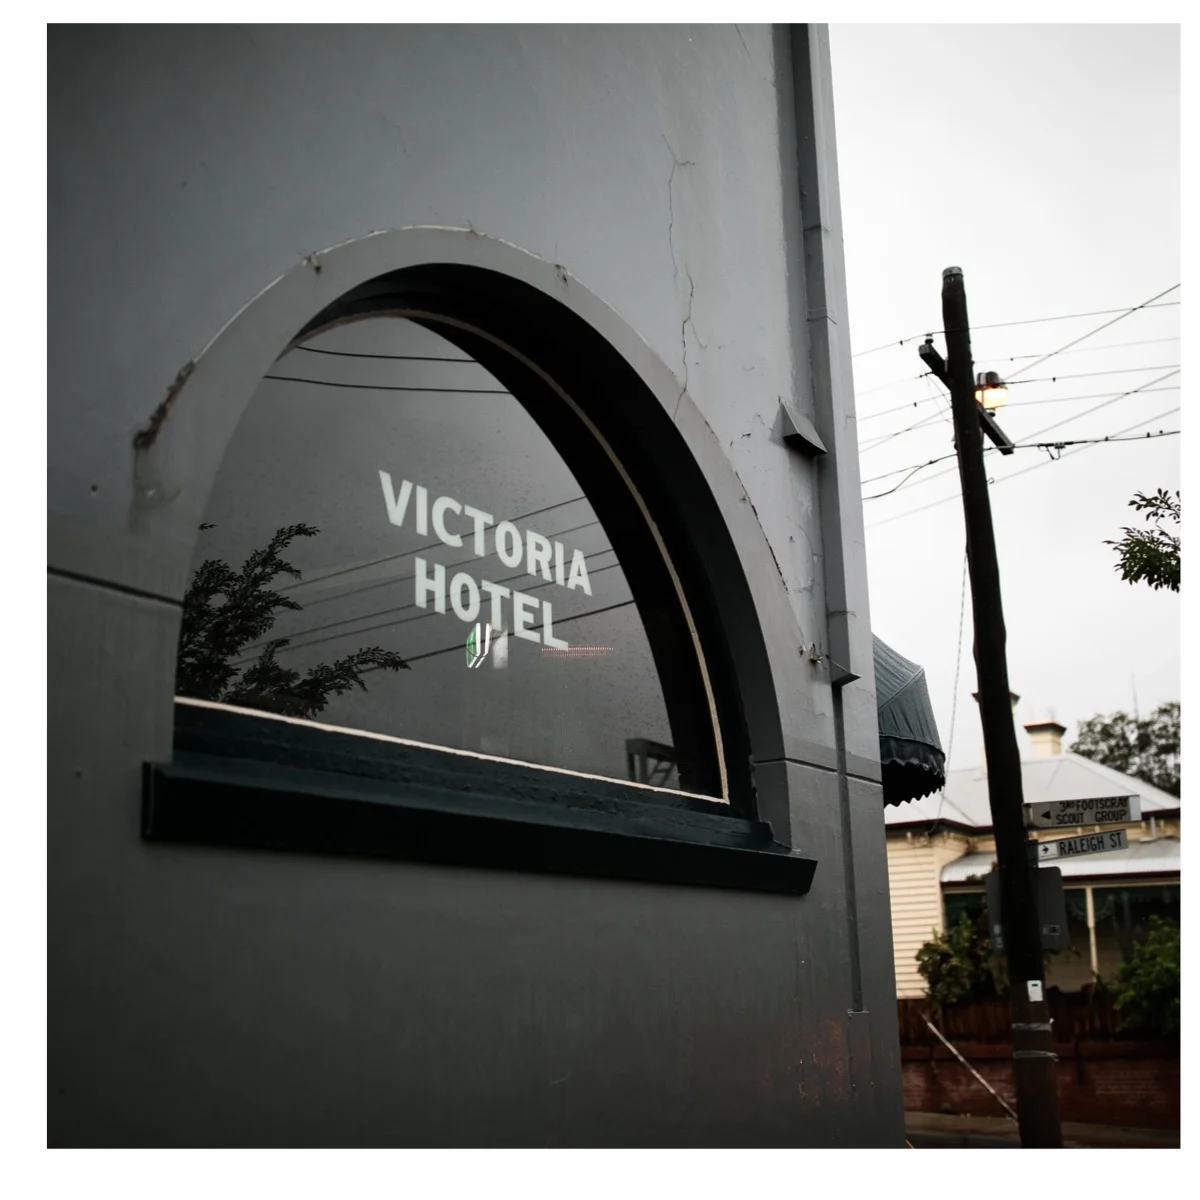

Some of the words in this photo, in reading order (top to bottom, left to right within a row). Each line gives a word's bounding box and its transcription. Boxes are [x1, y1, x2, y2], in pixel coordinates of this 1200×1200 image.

[378, 469, 593, 596] VICTORIA
[415, 556, 569, 652] HOTEL
[1076, 796, 1129, 811] FOOTSCRAY
[1056, 813, 1084, 825] SCOUT
[1095, 809, 1127, 822] GROUP
[1059, 836, 1105, 856] RALEIGH
[1110, 833, 1122, 849] ST
